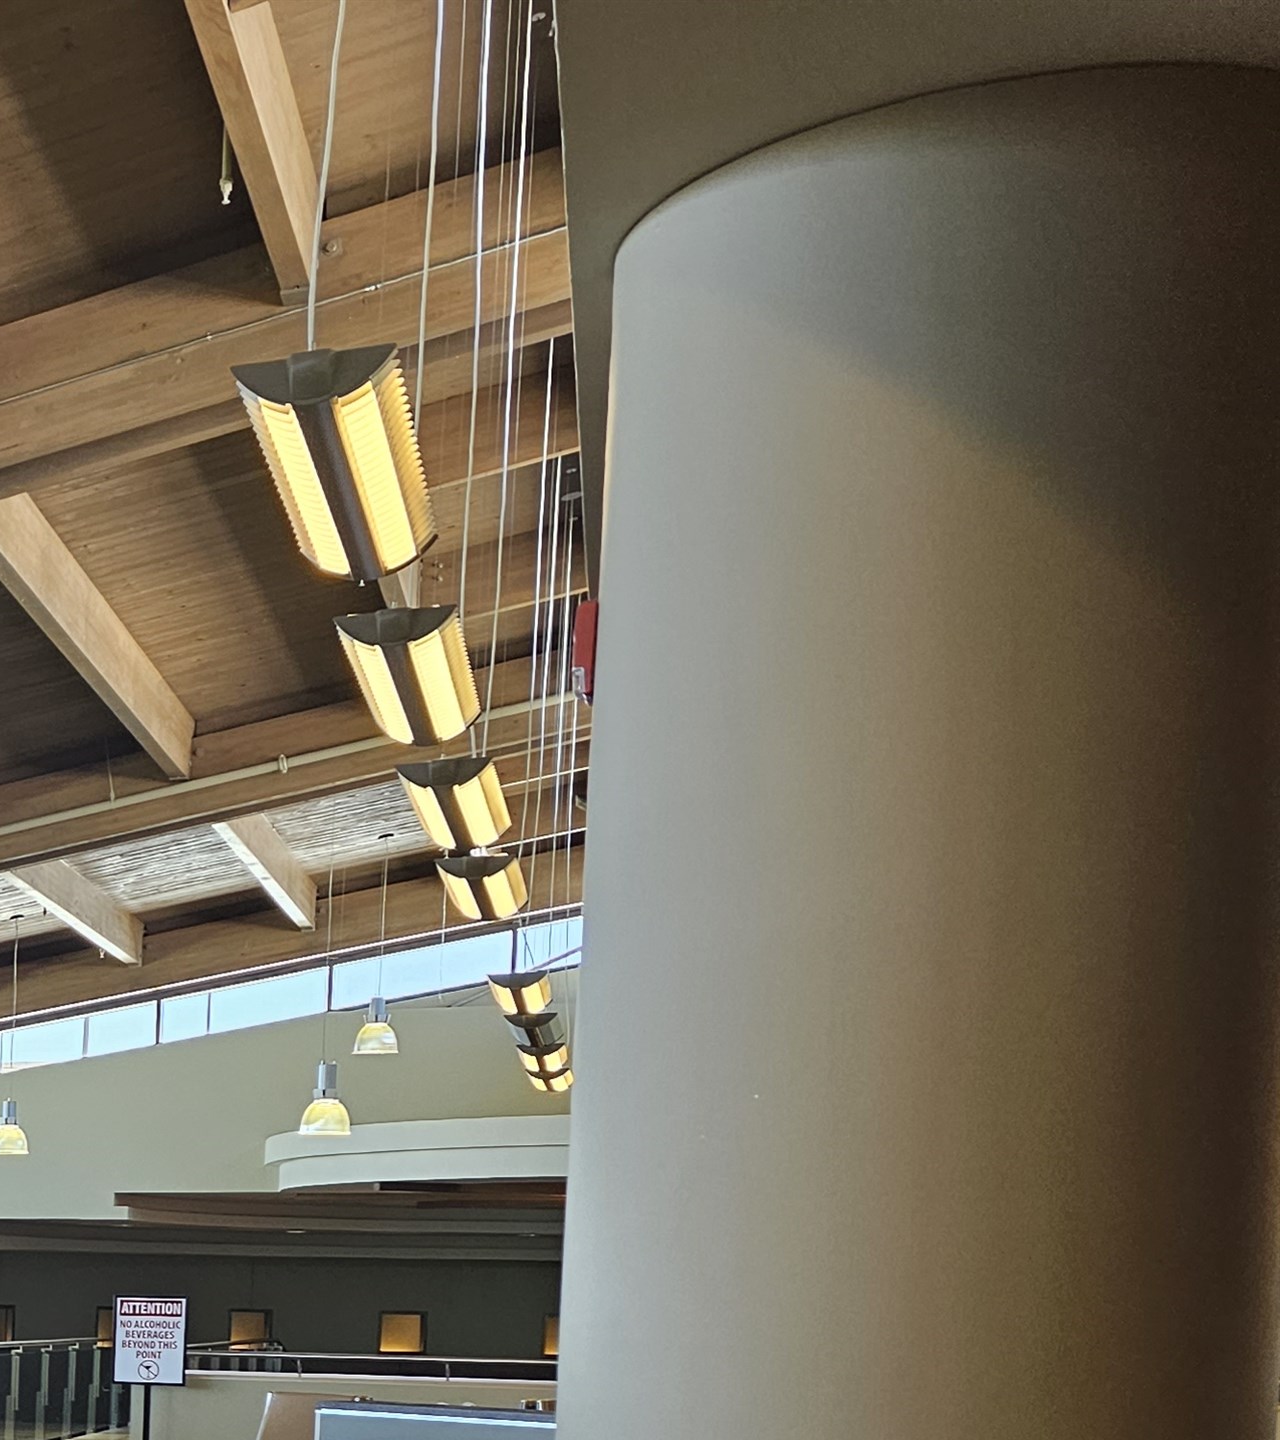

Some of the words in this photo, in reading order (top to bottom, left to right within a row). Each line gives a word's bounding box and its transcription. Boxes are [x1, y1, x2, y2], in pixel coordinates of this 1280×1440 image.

[121, 1301, 181, 1315] ATTENTION
[120, 1320, 132, 1329] NO
[134, 1320, 181, 1329] ALCOHOLIC
[125, 1330, 175, 1339] BEVERAGES
[121, 1340, 156, 1349] BEYOND
[158, 1340, 178, 1349] THIS
[136, 1350, 162, 1359] POINT
